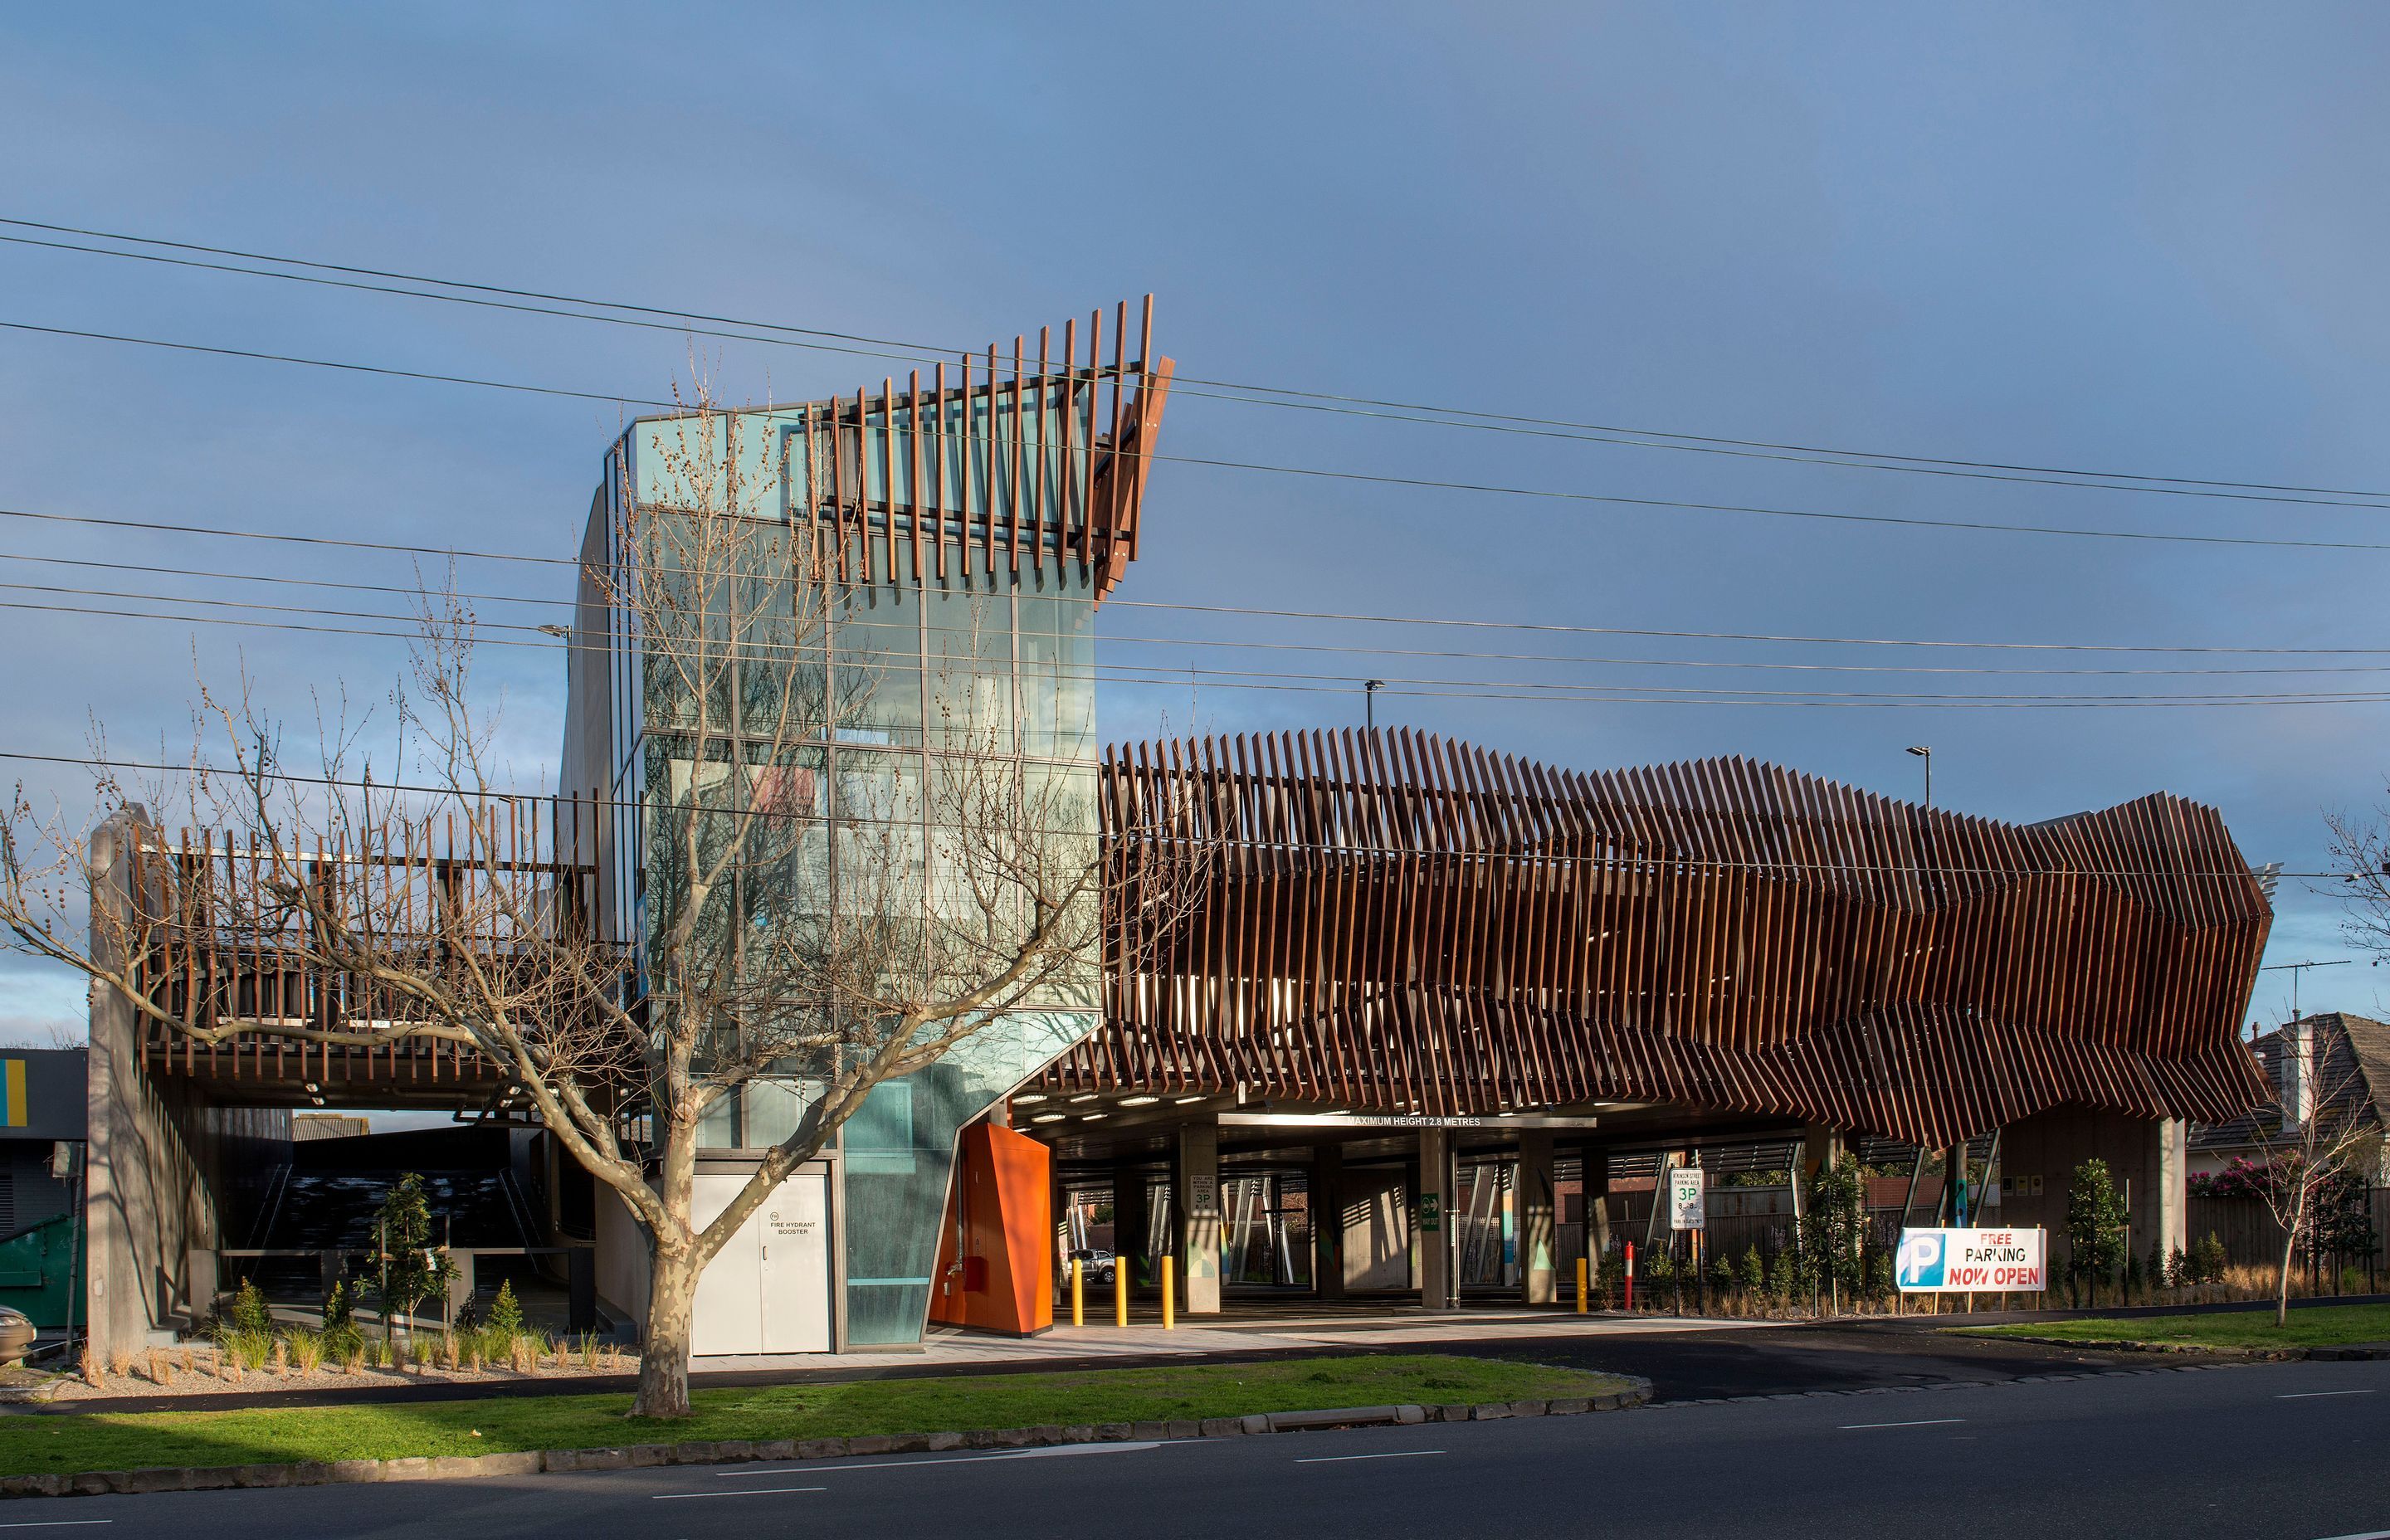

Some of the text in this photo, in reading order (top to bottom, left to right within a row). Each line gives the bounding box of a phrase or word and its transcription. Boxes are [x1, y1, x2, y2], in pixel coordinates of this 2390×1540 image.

[1347, 1117, 1392, 1125] MAXIMUM
[1429, 1118, 1441, 1126] 2.8
[1444, 1118, 1480, 1126] METRES
[1196, 1194, 1210, 1203] 3P
[1679, 1188, 1696, 1201] 3P
[1980, 1233, 2012, 1245] FREE
[1910, 1236, 1940, 1284] P
[1965, 1248, 2026, 1262] PARKING
[1949, 1267, 2039, 1285] NOW OPEN
